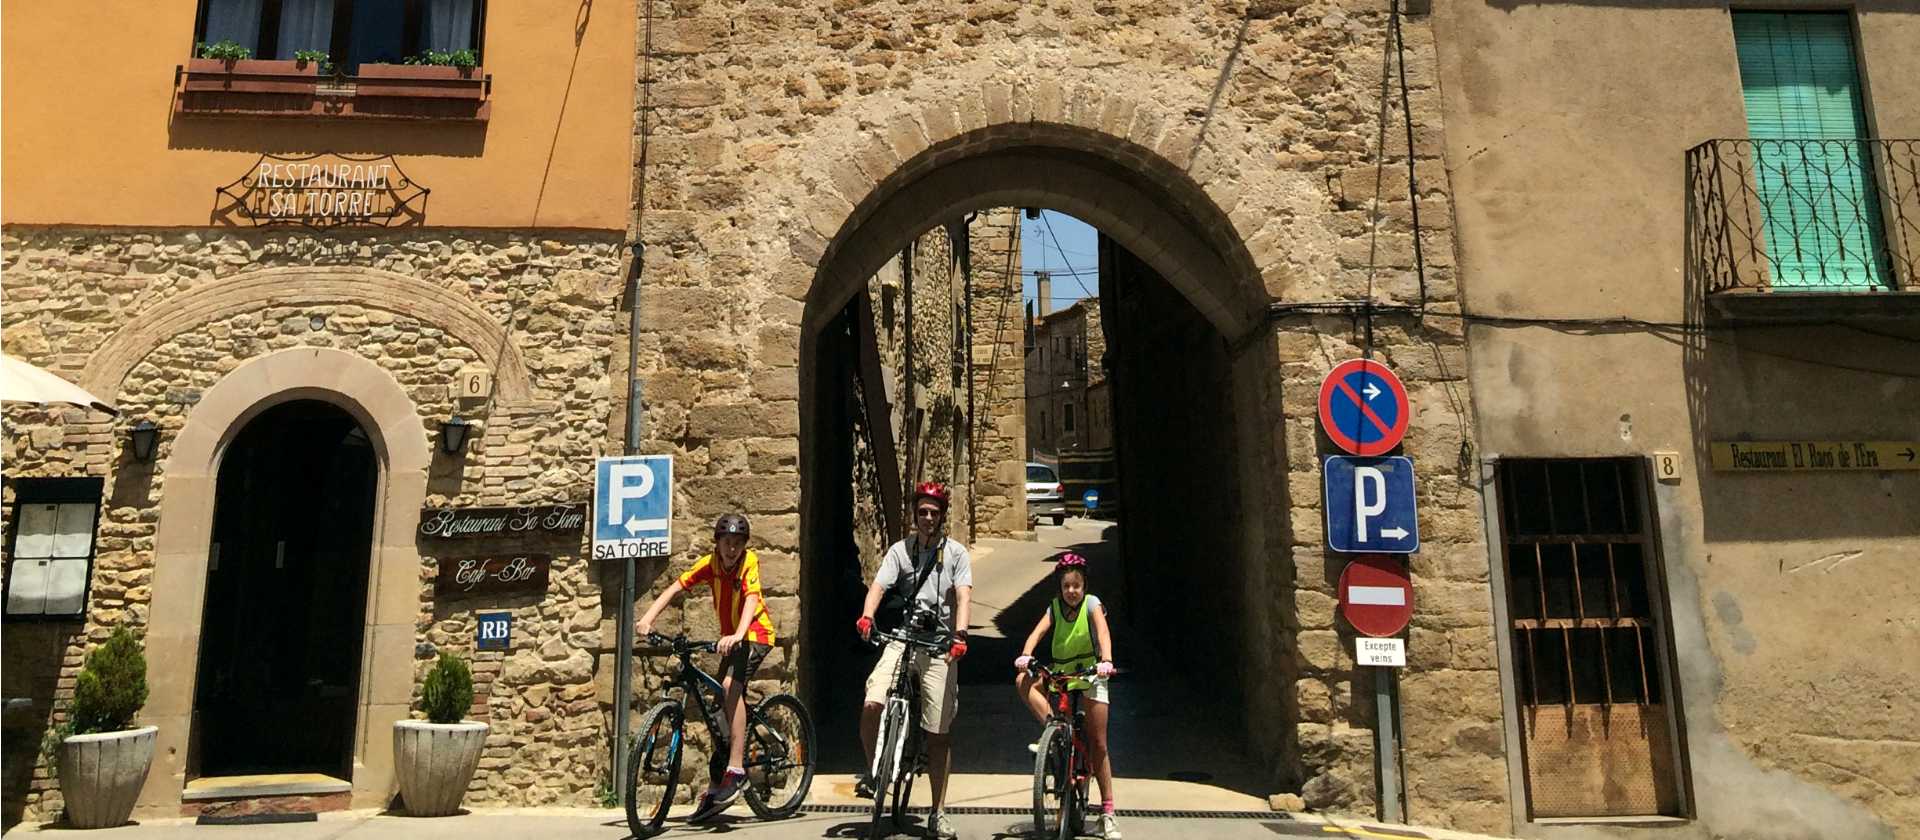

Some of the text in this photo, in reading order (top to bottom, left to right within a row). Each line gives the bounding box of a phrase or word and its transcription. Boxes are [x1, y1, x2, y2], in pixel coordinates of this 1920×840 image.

[258, 163, 392, 188] RESTAURANT
[270, 191, 376, 216] SA TORRE
[470, 375, 480, 394] 6
[1663, 456, 1674, 476] 8
[1731, 443, 1788, 468] Restaurant
[1792, 443, 1804, 468] El
[1838, 443, 1850, 468] de
[608, 463, 655, 526] P
[1355, 466, 1386, 543] P
[421, 503, 584, 537] Restaurant Sa Torre
[595, 541, 668, 559] SA TORRE
[482, 620, 508, 639] RB
[1364, 640, 1397, 652] Excepte
